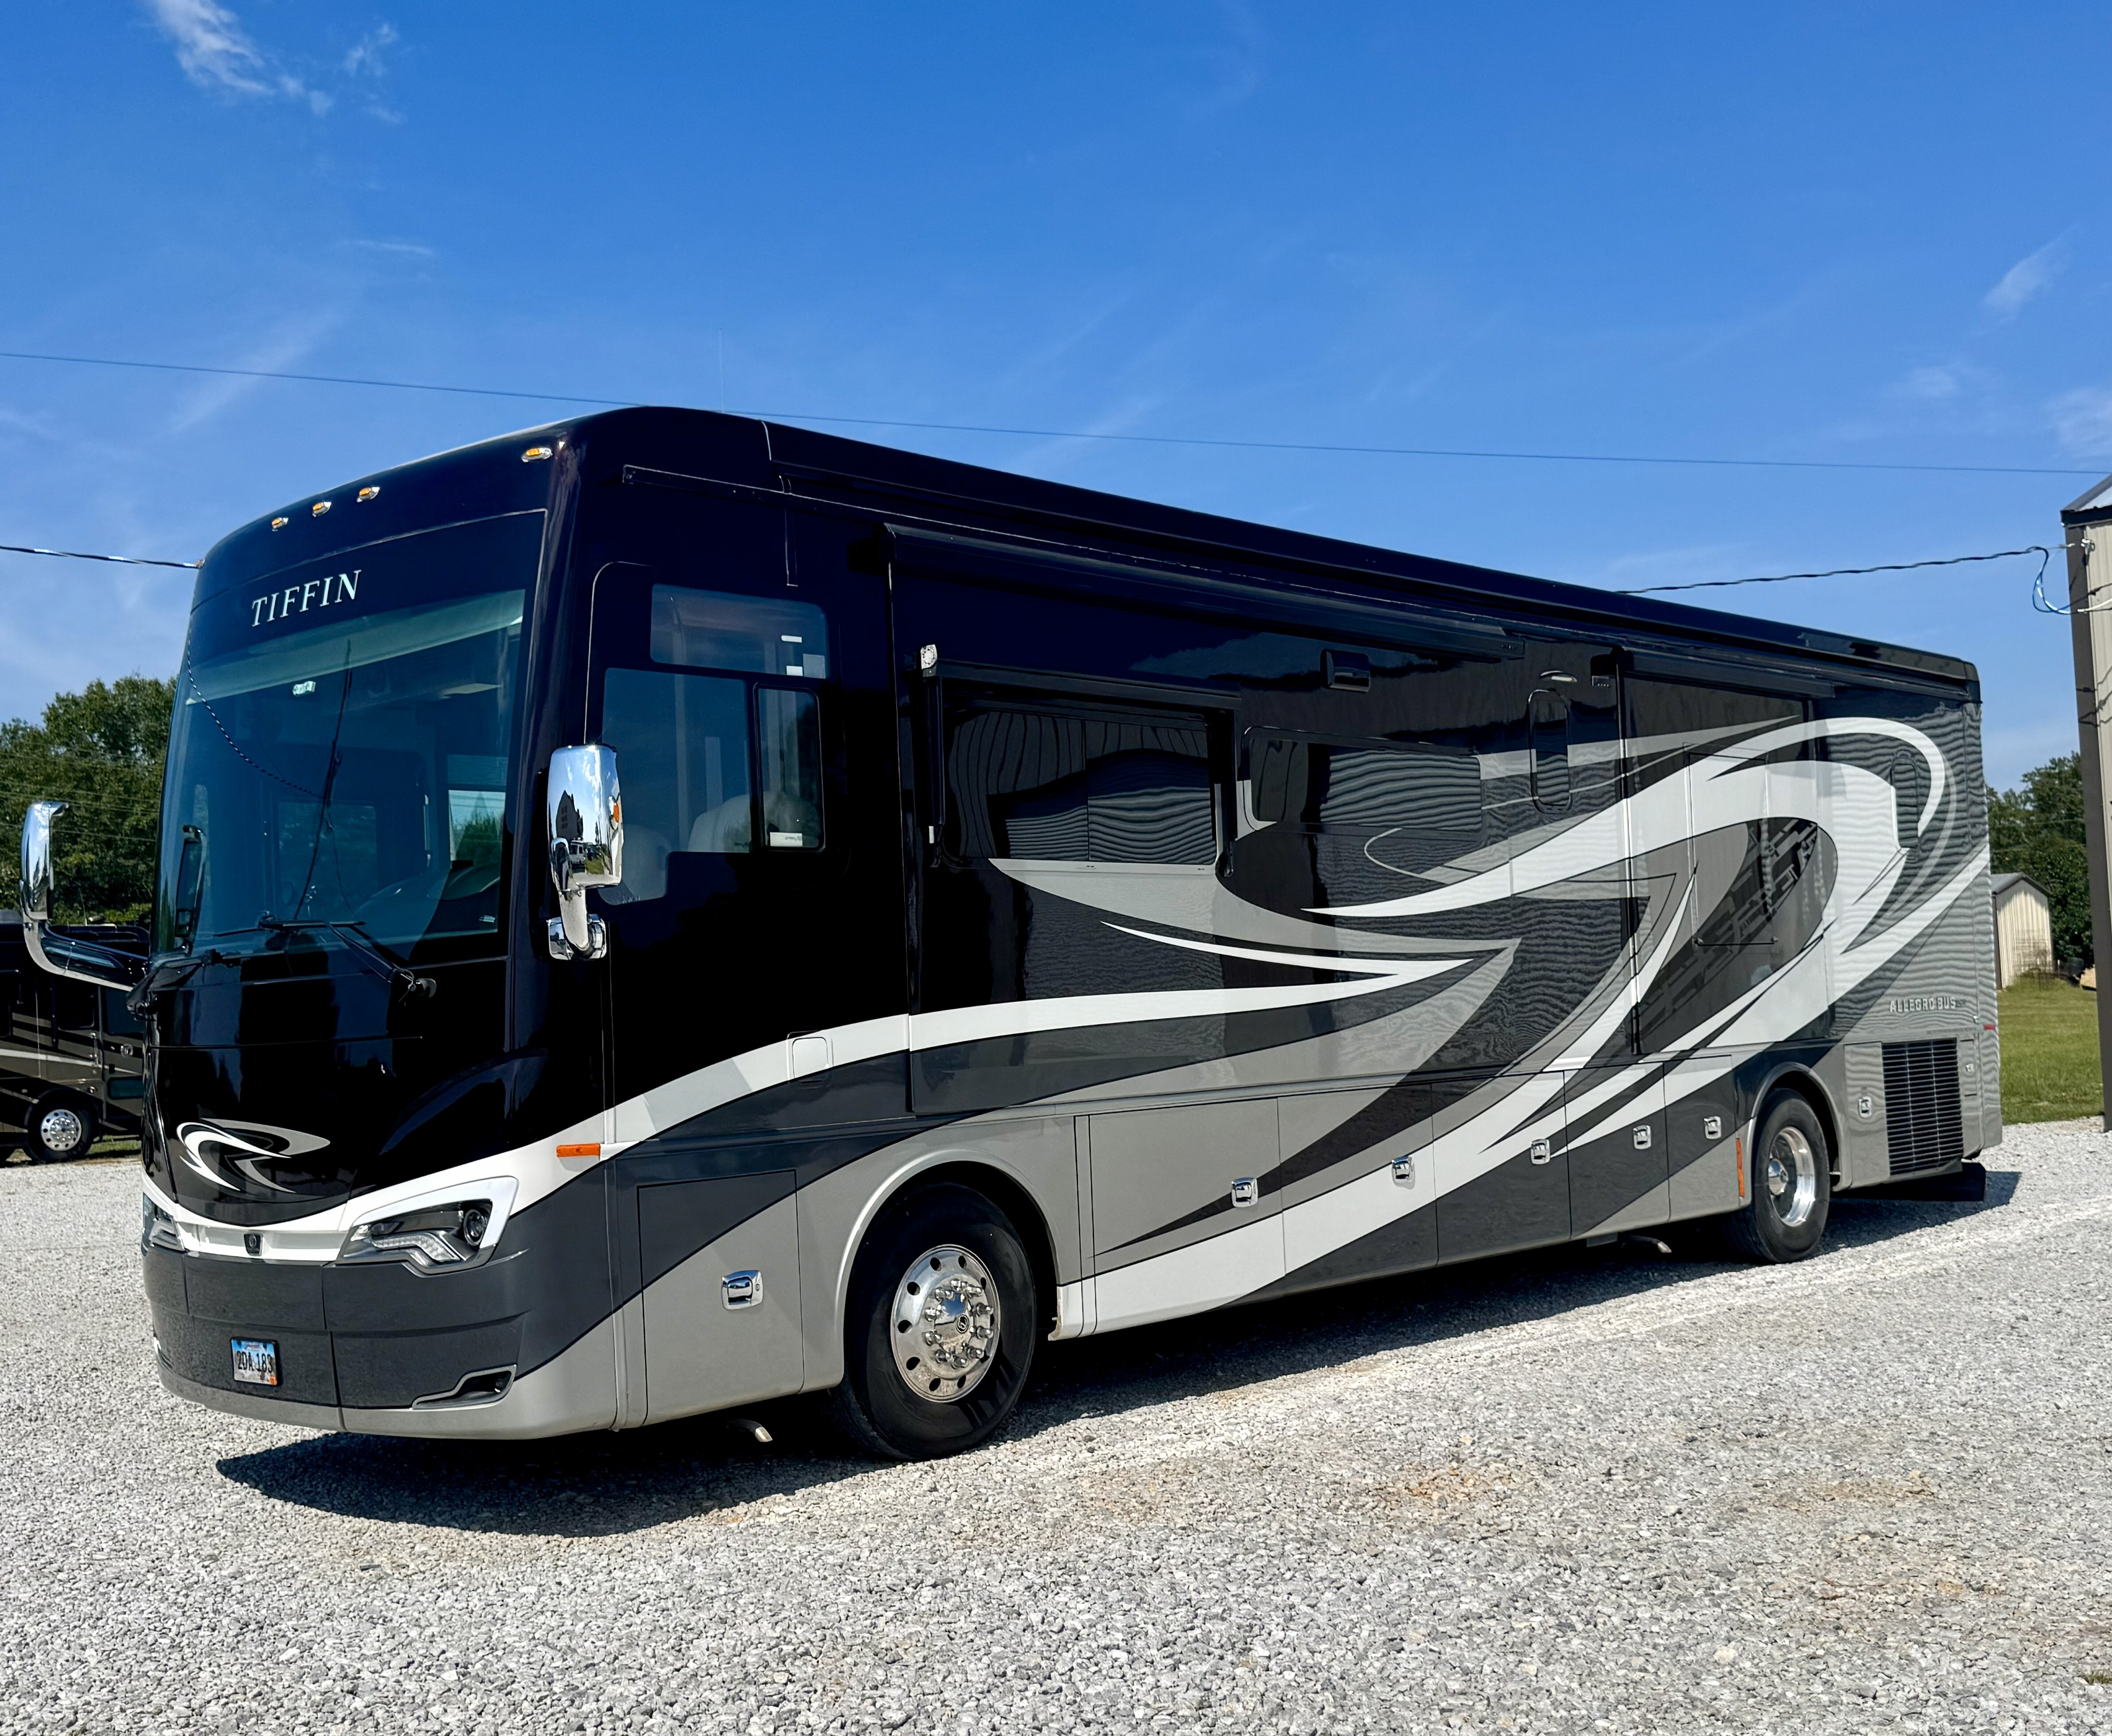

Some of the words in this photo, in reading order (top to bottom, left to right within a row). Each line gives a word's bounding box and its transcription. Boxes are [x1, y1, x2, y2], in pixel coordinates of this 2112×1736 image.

[252, 570, 362, 627] TIFFIN
[1890, 998, 1935, 1013] ALLEGRO
[1937, 997, 1956, 1010] BUS
